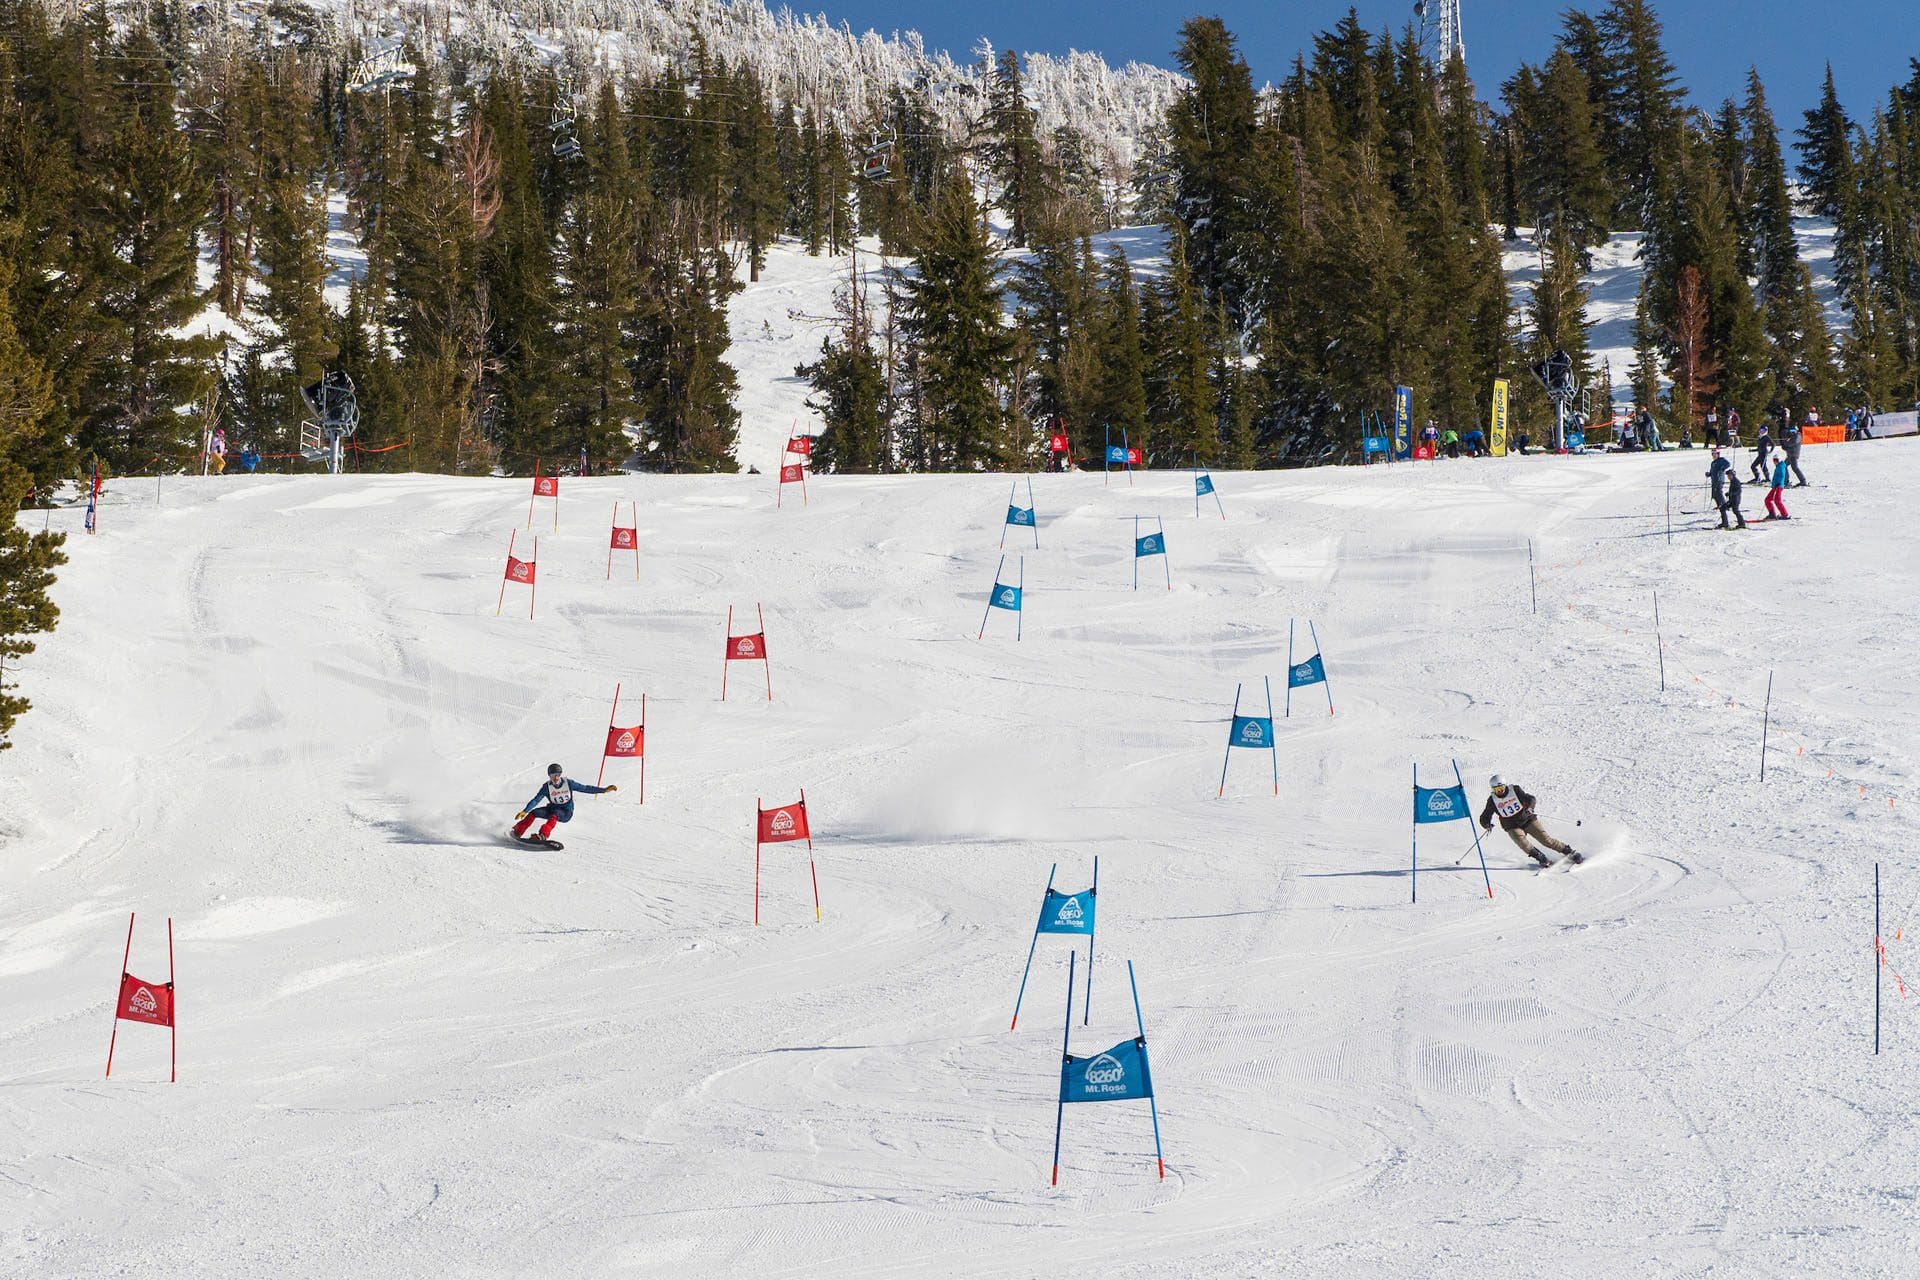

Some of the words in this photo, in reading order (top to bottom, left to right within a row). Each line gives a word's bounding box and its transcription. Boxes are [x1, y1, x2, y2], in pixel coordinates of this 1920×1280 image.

[1502, 802, 1520, 816] 135
[1085, 1085, 1100, 1093] Mt.
[1101, 1084, 1127, 1093] Rose
